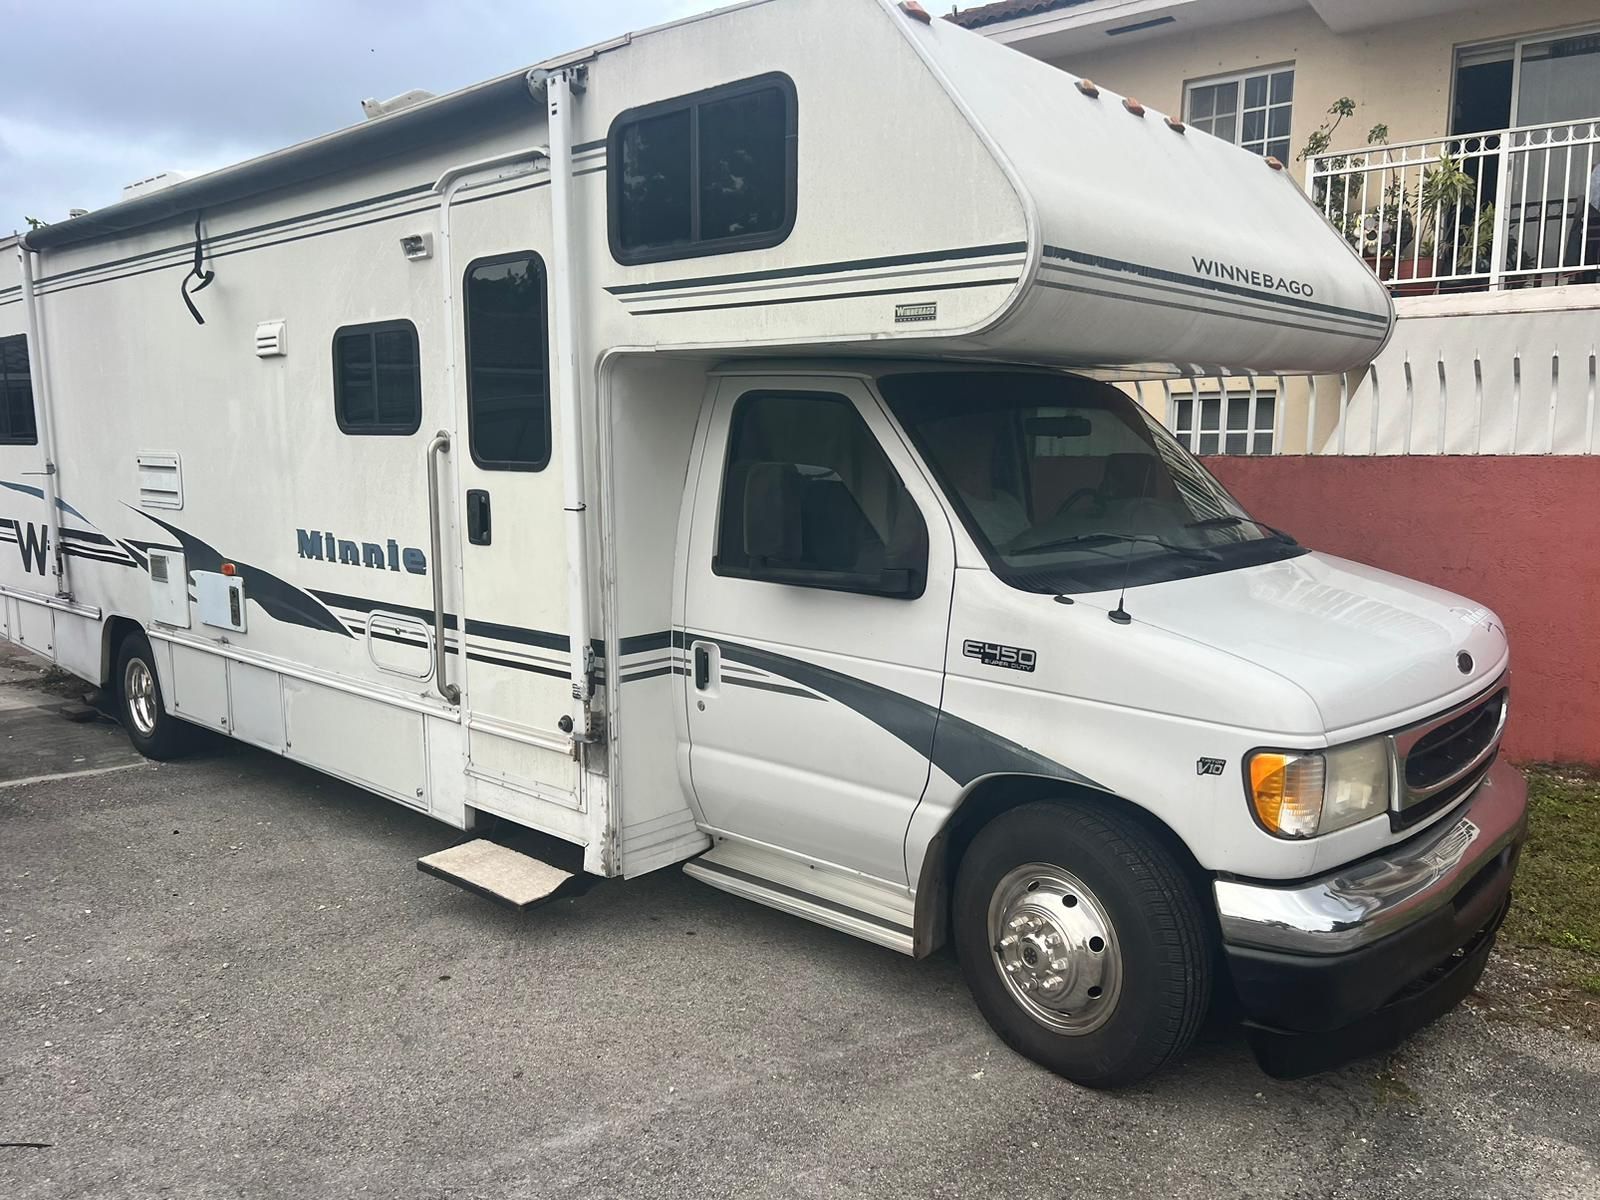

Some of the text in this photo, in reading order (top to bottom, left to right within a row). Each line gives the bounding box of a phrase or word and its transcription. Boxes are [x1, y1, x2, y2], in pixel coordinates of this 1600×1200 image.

[1191, 256, 1314, 297] WINNEBAGO
[13, 519, 48, 577] W
[296, 528, 427, 576] Minnie
[984, 658, 1032, 671] SUPER DUTY
[1198, 761, 1223, 774] V10
